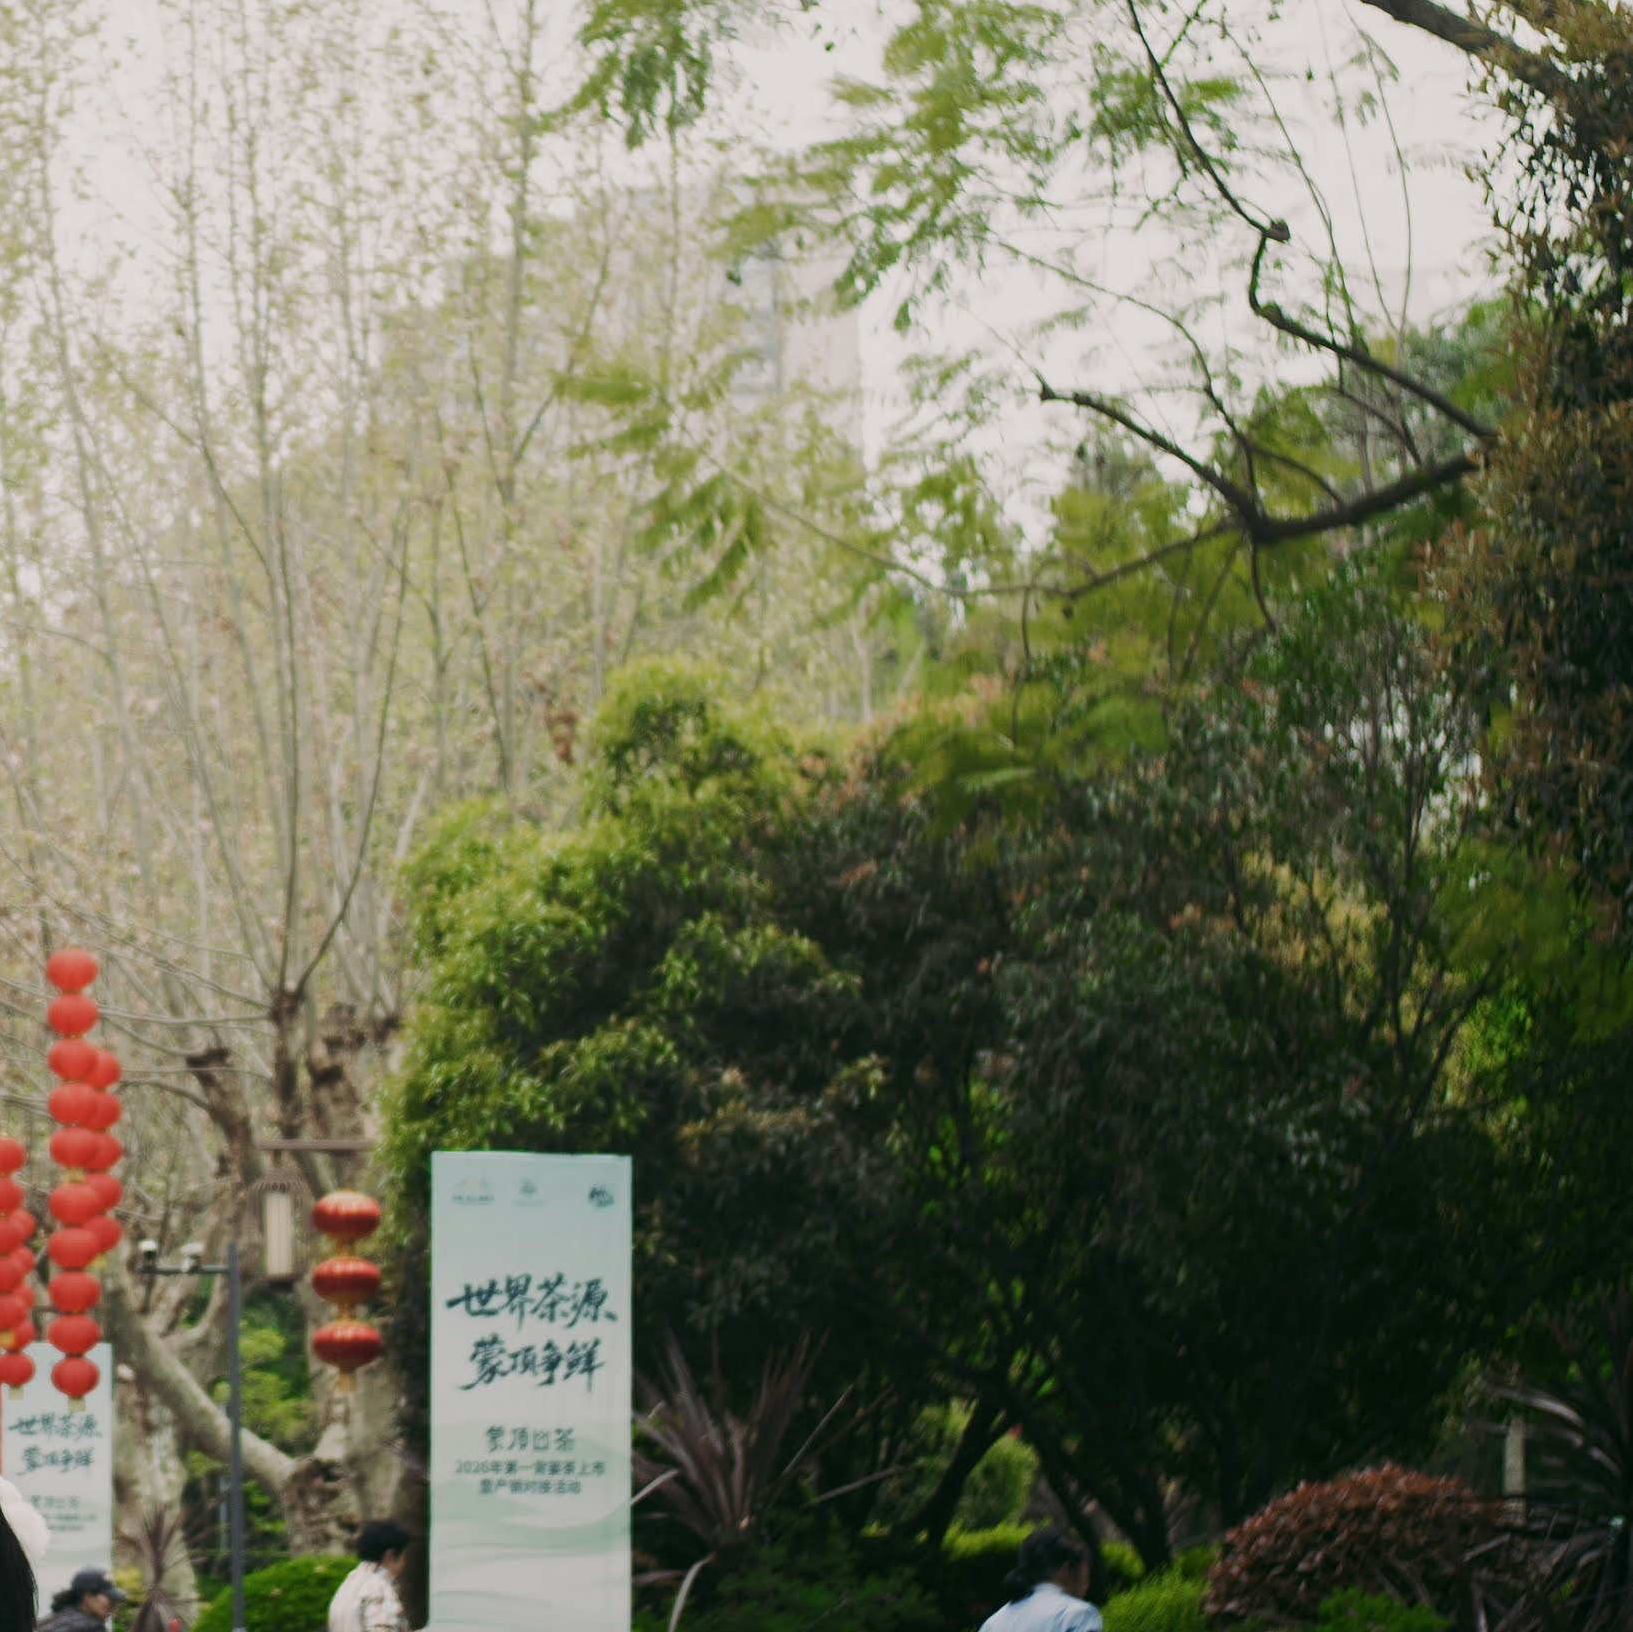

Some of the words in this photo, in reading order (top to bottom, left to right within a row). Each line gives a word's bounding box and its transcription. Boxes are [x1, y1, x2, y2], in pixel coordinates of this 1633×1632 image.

[445, 1271, 619, 1331] 世界茶源
[455, 1332, 605, 1394] 蒙顶争鲜
